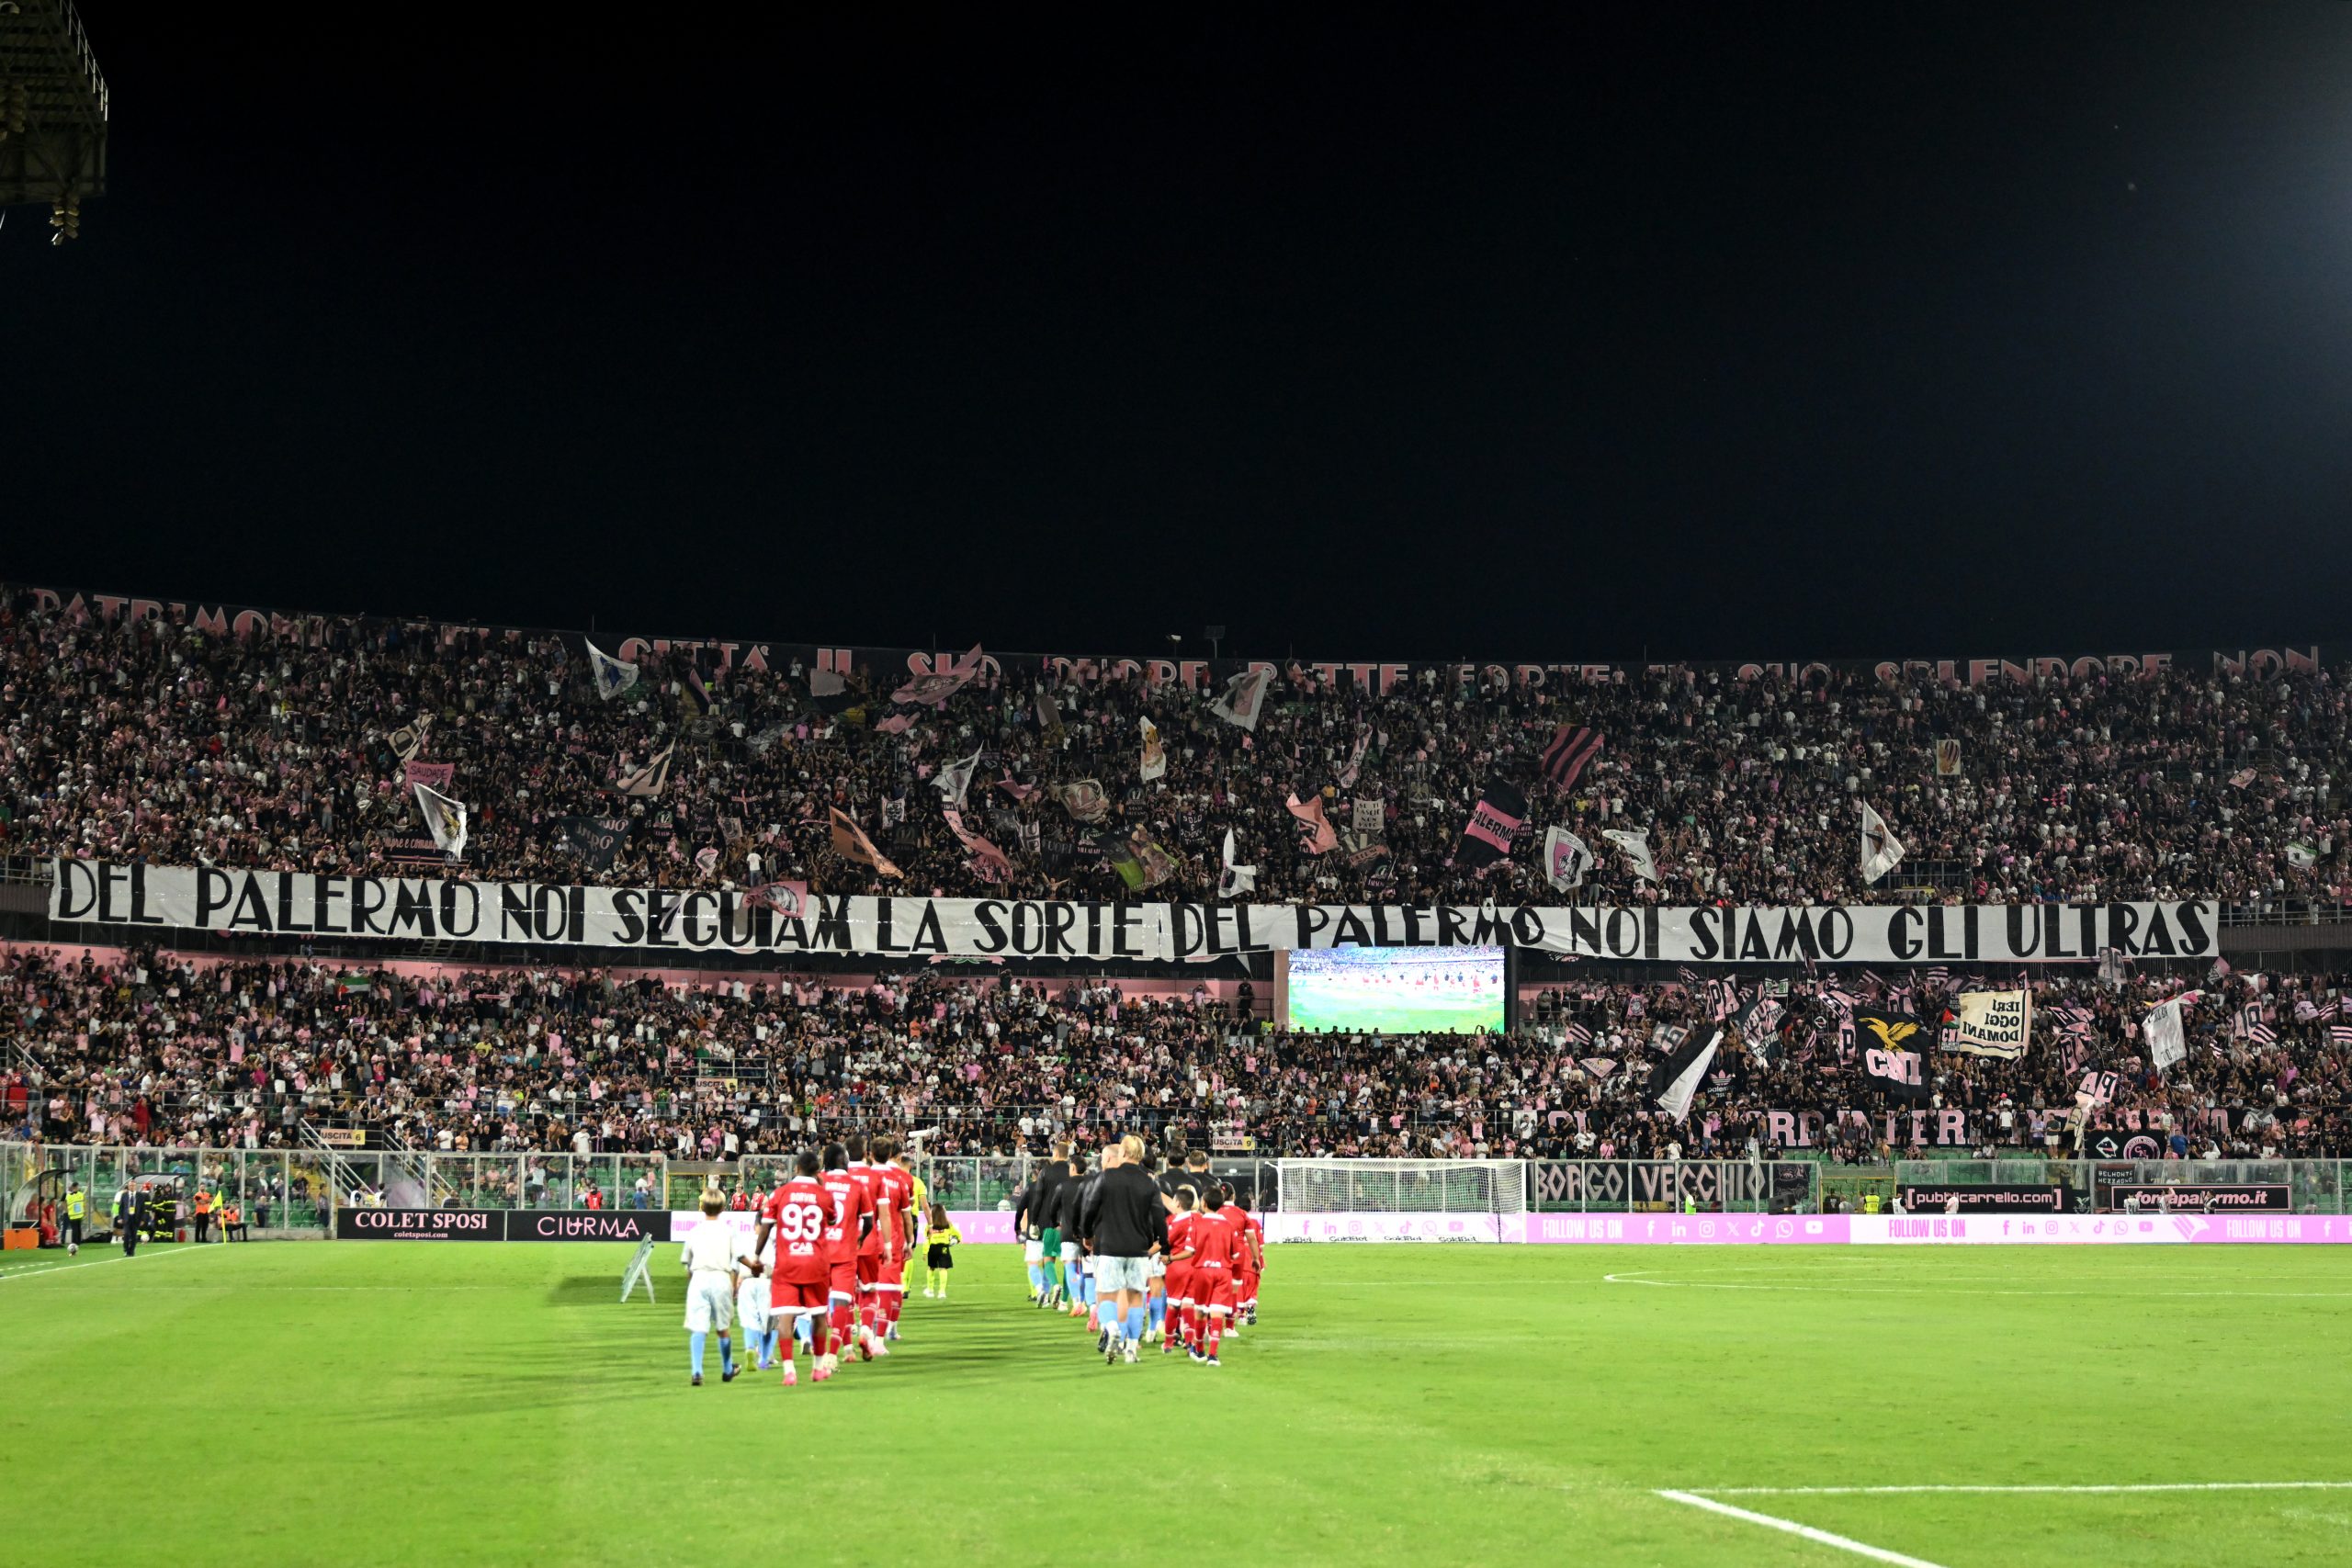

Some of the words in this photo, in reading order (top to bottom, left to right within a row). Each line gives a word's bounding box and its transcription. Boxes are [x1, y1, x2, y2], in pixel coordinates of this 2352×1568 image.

[1473, 808, 1516, 843] PALERMO
[59, 859, 164, 924] DEL
[196, 867, 480, 938] PALERMO
[501, 883, 585, 942] NOI
[612, 889, 853, 951] SEGUIAM
[877, 897, 948, 953] LA
[973, 900, 1144, 956] SORTE
[1170, 902, 1270, 957] DEL
[1296, 905, 1545, 949] PALERMO
[1571, 905, 1659, 959] NOI
[1689, 906, 1854, 961] SIAMO
[1888, 904, 1979, 961] GLI
[2006, 900, 2211, 958] ULTRAS
[1865, 1049, 1922, 1086] CNI
[322, 1132, 353, 1140] USCITA
[1530, 1163, 1624, 1202] BORGO
[1637, 1163, 1767, 1202] VECCHIO
[355, 1212, 429, 1228] COLET
[433, 1213, 489, 1229] SPOSI
[537, 1216, 640, 1237] CIURMA
[781, 1203, 823, 1242] 93
[1543, 1219, 1585, 1239] FOLLOW
[1589, 1219, 1604, 1239] US
[1607, 1219, 1623, 1239] ON
[1889, 1219, 1929, 1238] FOLLOW
[1933, 1219, 1948, 1238] US
[1951, 1219, 1966, 1238] ON
[2226, 1220, 2267, 1238] FOLLOW
[2269, 1220, 2283, 1238] US
[2284, 1220, 2301, 1238] ON
[393, 1230, 448, 1239] coletsposi.com
